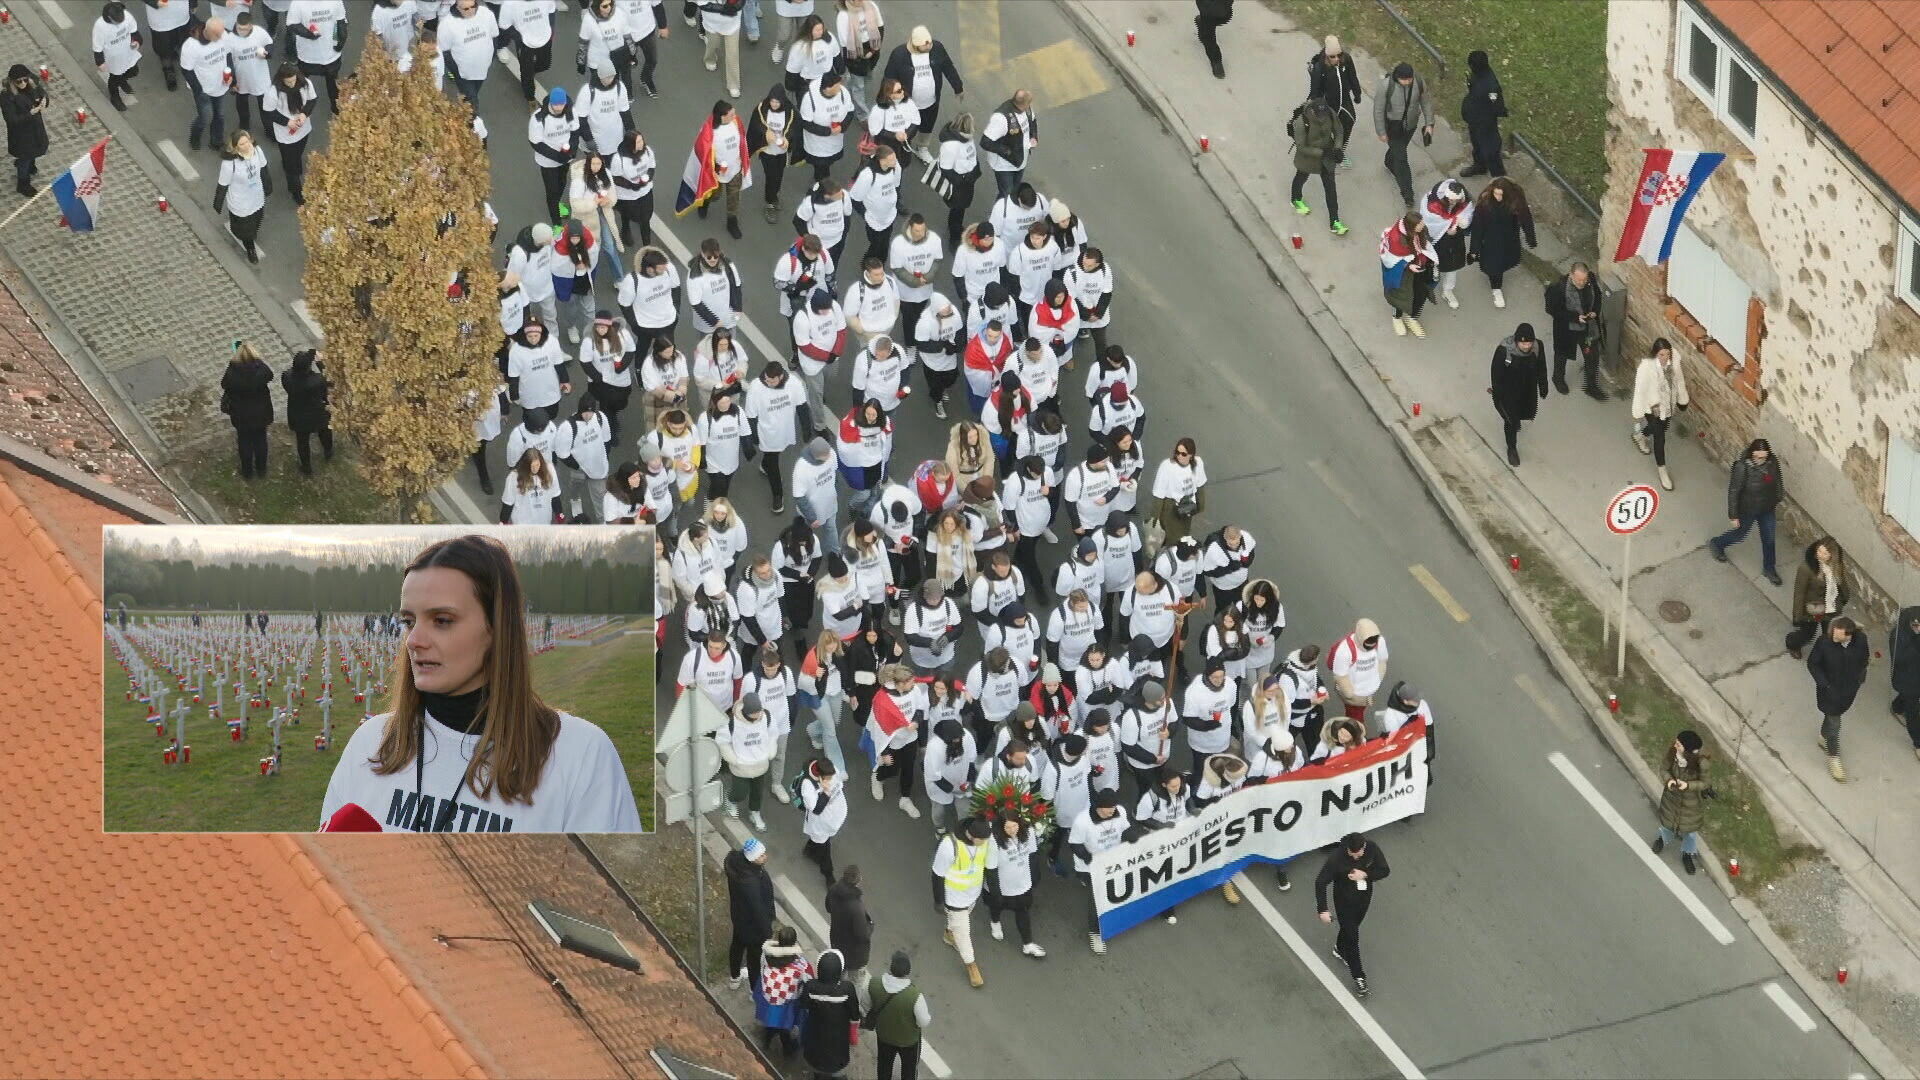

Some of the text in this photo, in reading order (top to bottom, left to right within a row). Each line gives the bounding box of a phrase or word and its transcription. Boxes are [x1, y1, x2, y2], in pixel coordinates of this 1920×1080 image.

[1618, 496, 1647, 523] 50
[1362, 784, 1415, 814] HODAMO
[1105, 811, 1229, 876] ZA NAS ŽIVOTE DALI
[1106, 752, 1414, 904] UMJESTO NJIH
